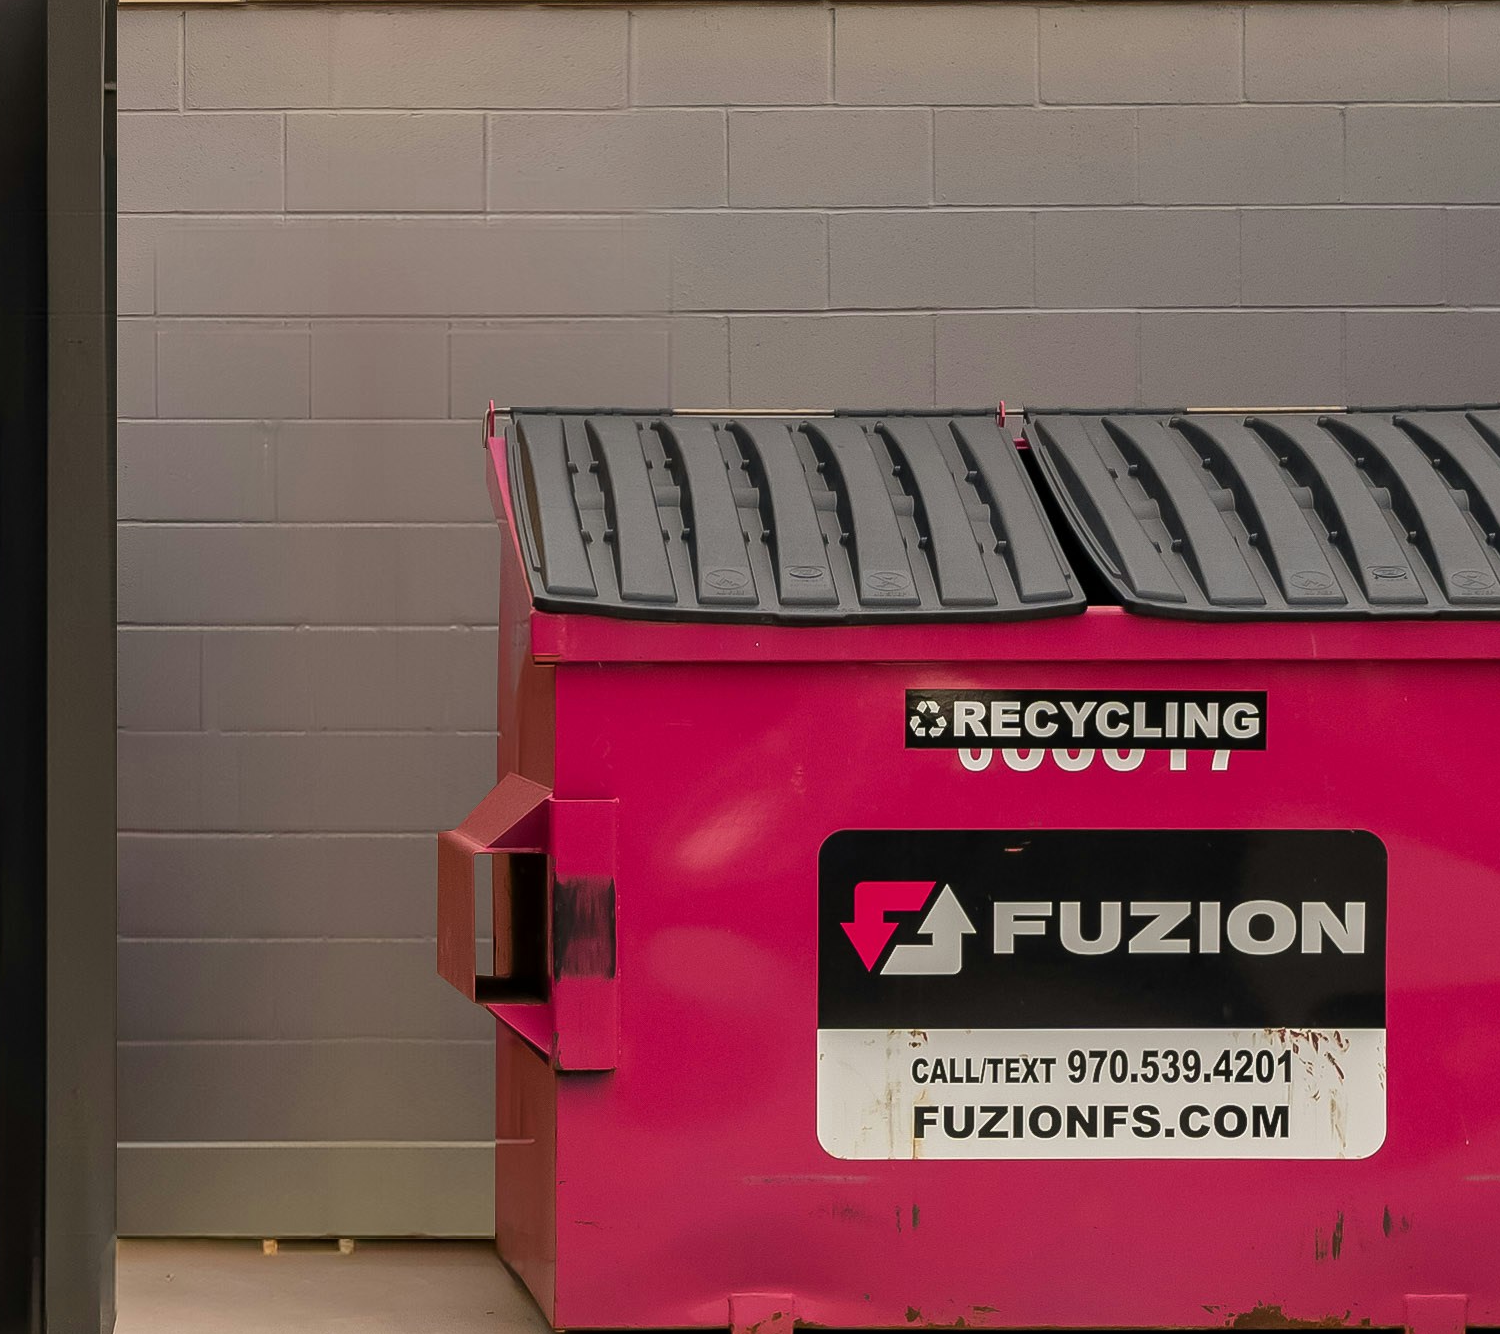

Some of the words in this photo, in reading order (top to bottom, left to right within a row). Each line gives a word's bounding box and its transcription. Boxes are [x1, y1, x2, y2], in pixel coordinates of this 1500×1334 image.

[953, 701, 1260, 739] RECYCLING
[993, 900, 1366, 955] FUZION
[912, 1057, 1057, 1084] CALL/TEXT
[1067, 1049, 1292, 1084] 970.539.4201
[913, 1105, 1289, 1139] FUZIONFS.COM
